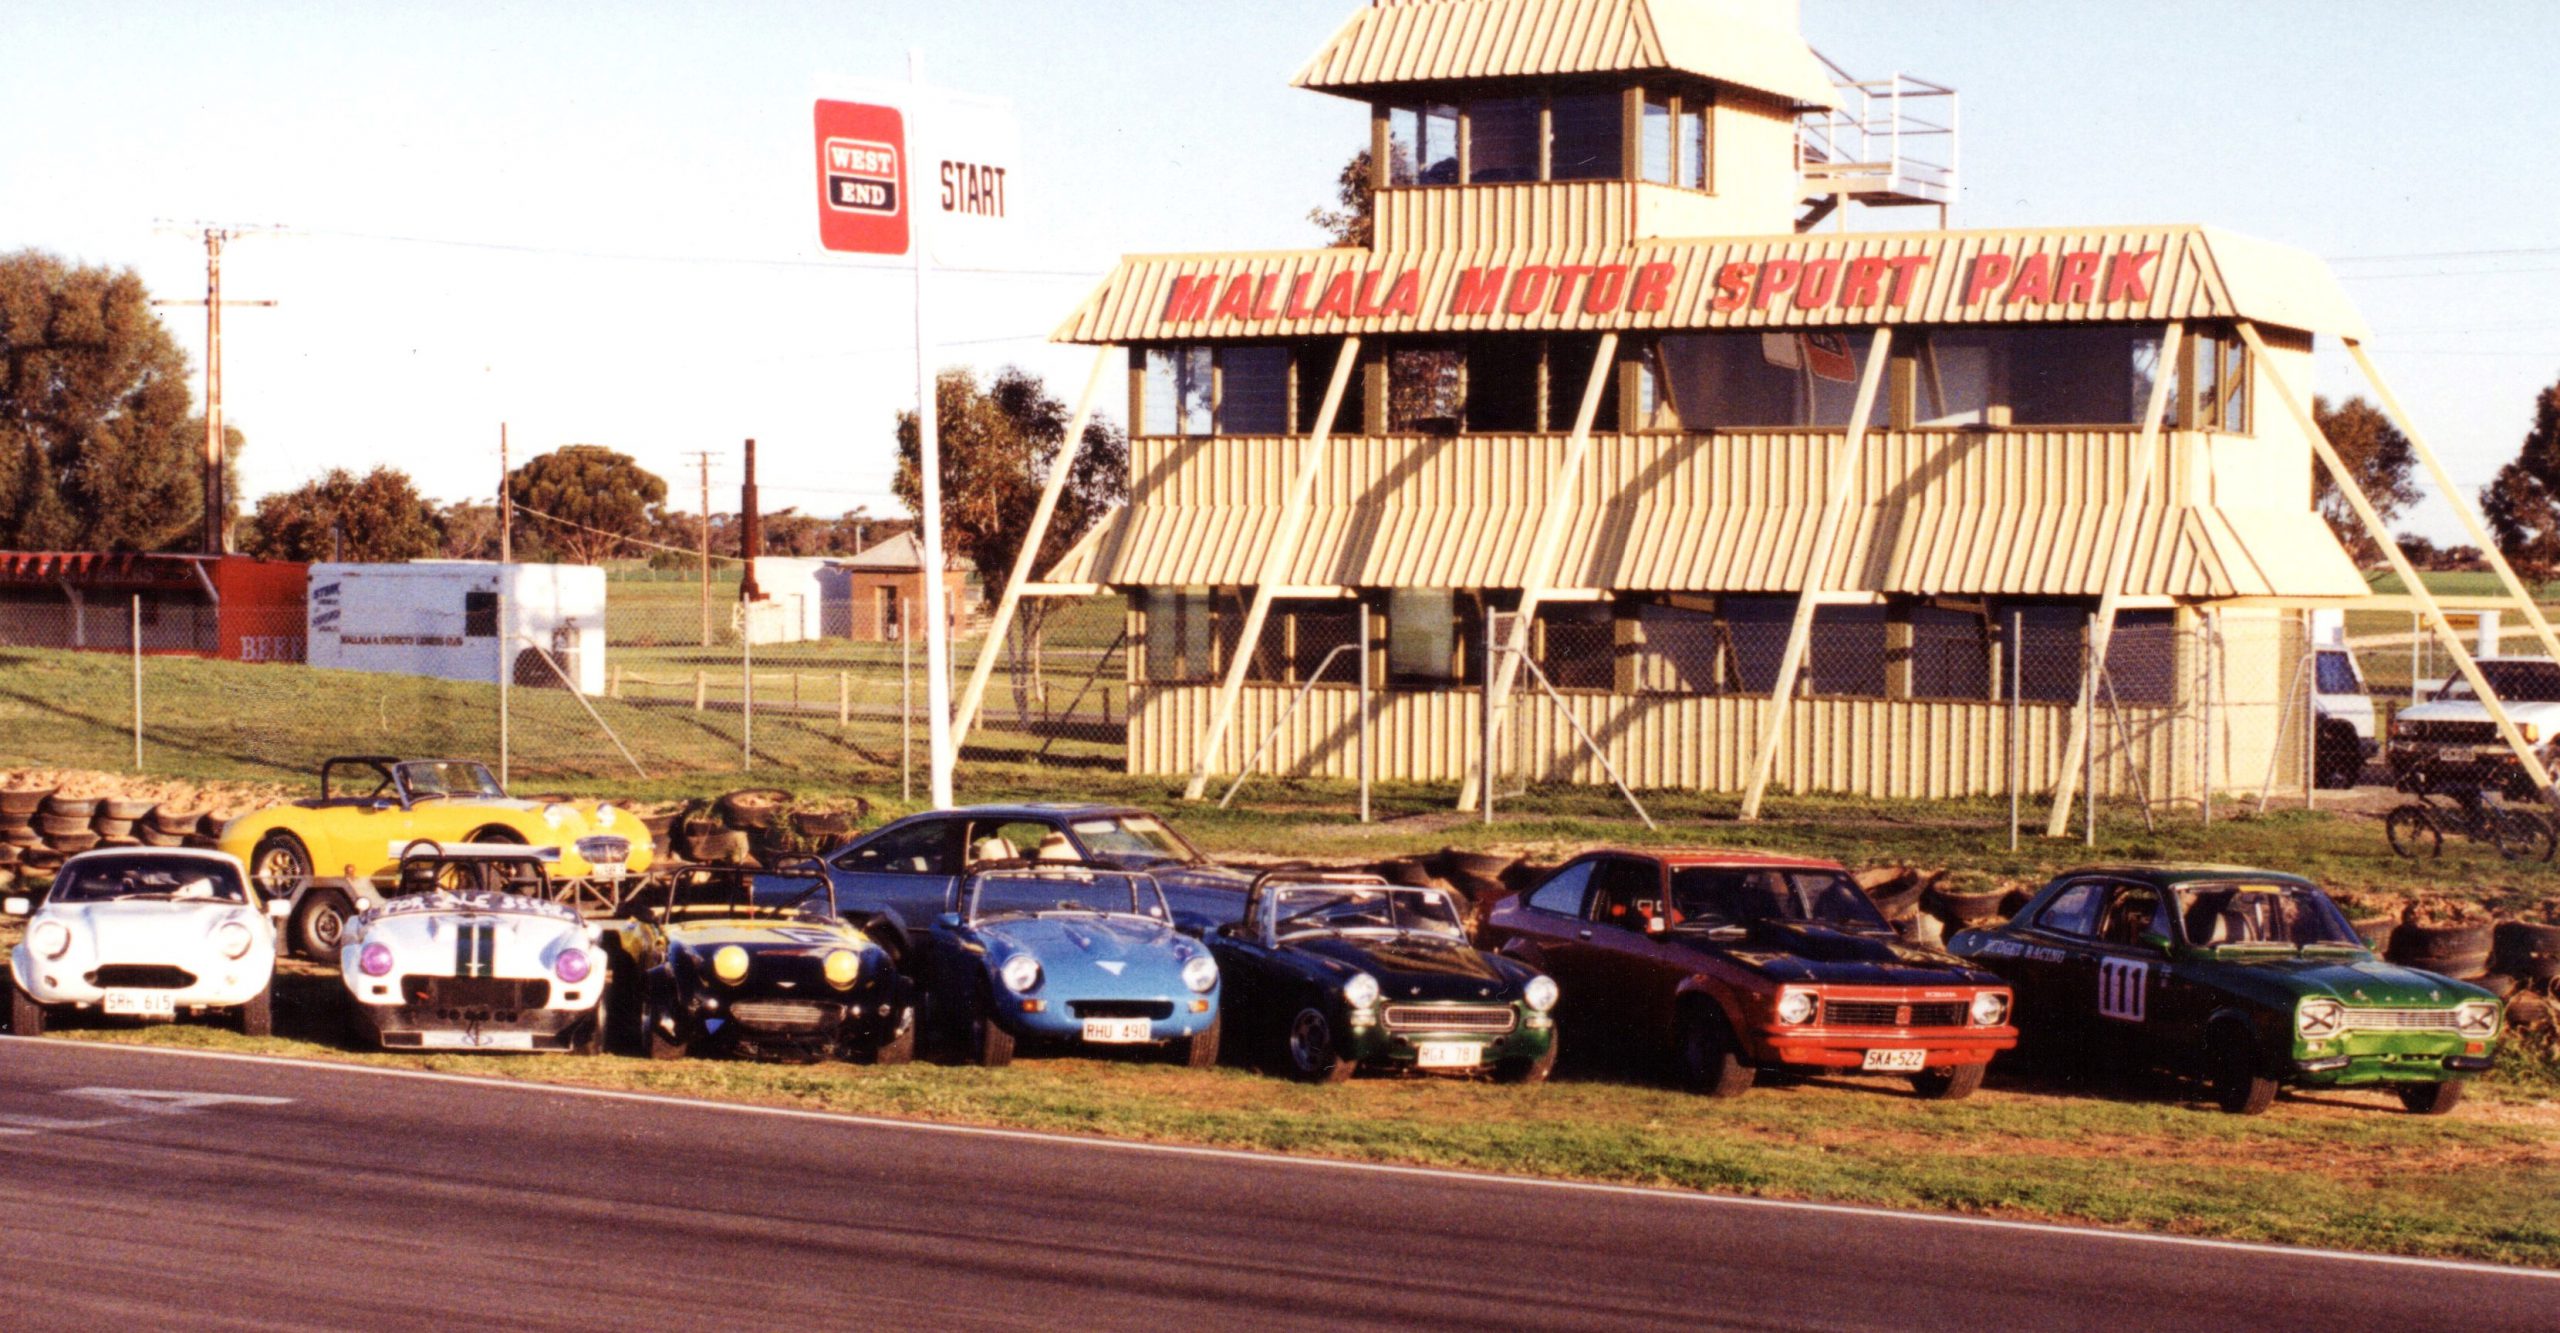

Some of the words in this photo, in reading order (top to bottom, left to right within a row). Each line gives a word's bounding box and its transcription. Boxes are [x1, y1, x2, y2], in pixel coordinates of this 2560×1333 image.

[831, 146, 892, 174] WEST
[840, 181, 887, 206] END
[940, 160, 1006, 218] START
[1160, 268, 1420, 322] MALLALA
[1449, 262, 1676, 316] MOTOR
[1709, 256, 1931, 313] SPORT
[1960, 250, 2160, 306] PARK
[1086, 1023, 1113, 1039] RHU
[1121, 1023, 1148, 1039] 490
